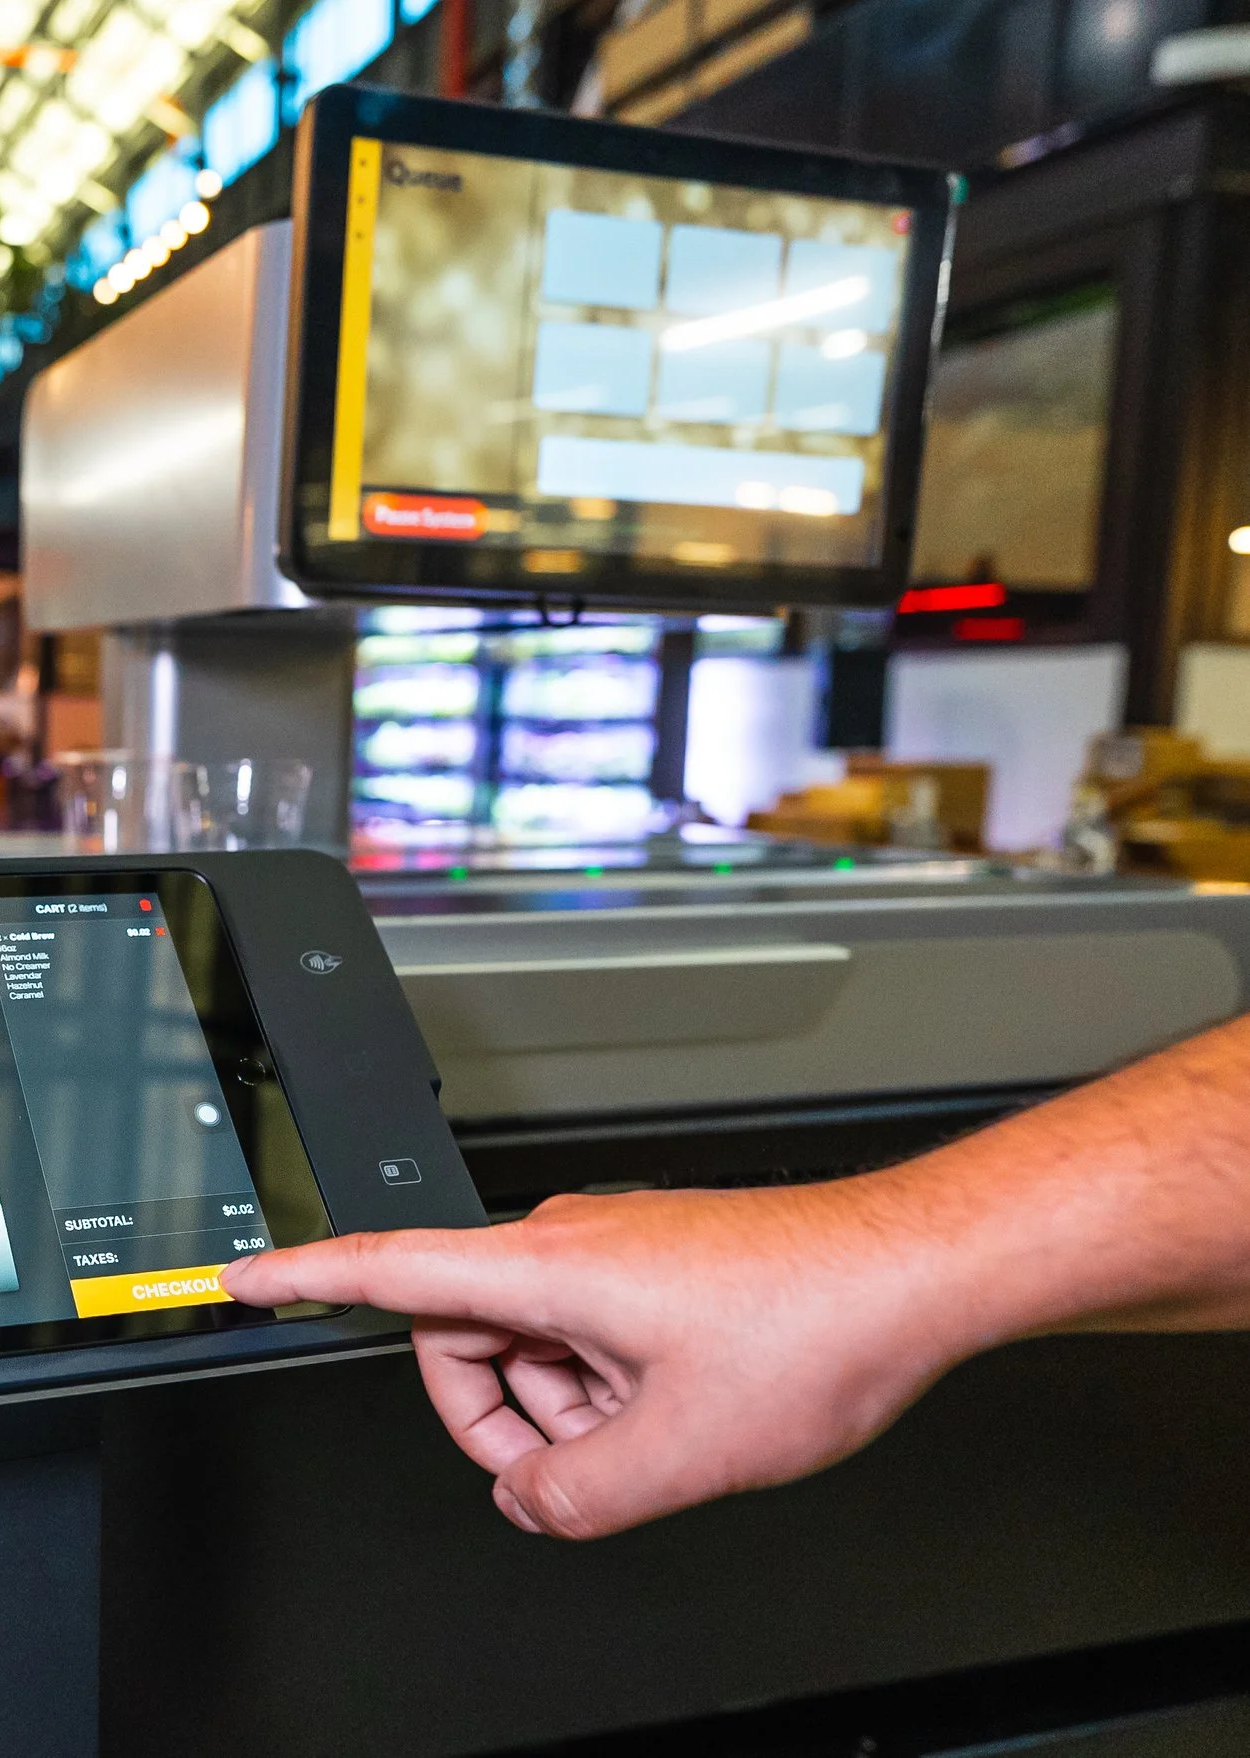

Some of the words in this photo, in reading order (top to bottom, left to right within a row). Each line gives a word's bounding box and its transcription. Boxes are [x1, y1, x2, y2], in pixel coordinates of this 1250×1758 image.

[35, 904, 65, 914] CART
[68, 904, 78, 914] (2
[78, 903, 108, 914] items)
[9, 932, 31, 942] Cold
[31, 931, 55, 941] Brew
[0, 953, 32, 962] Almond
[32, 952, 50, 961] Milk
[2, 963, 15, 971] No
[15, 961, 51, 971] Creamer
[6, 981, 43, 991] Hazelnut
[9, 990, 44, 1000] Caramel
[222, 1203, 255, 1217] $0.02
[65, 1215, 133, 1231] SUBTOTAL:
[233, 1237, 266, 1252] $0.00
[73, 1252, 119, 1267] TAXES:
[132, 1276, 219, 1300] CHECKOU
